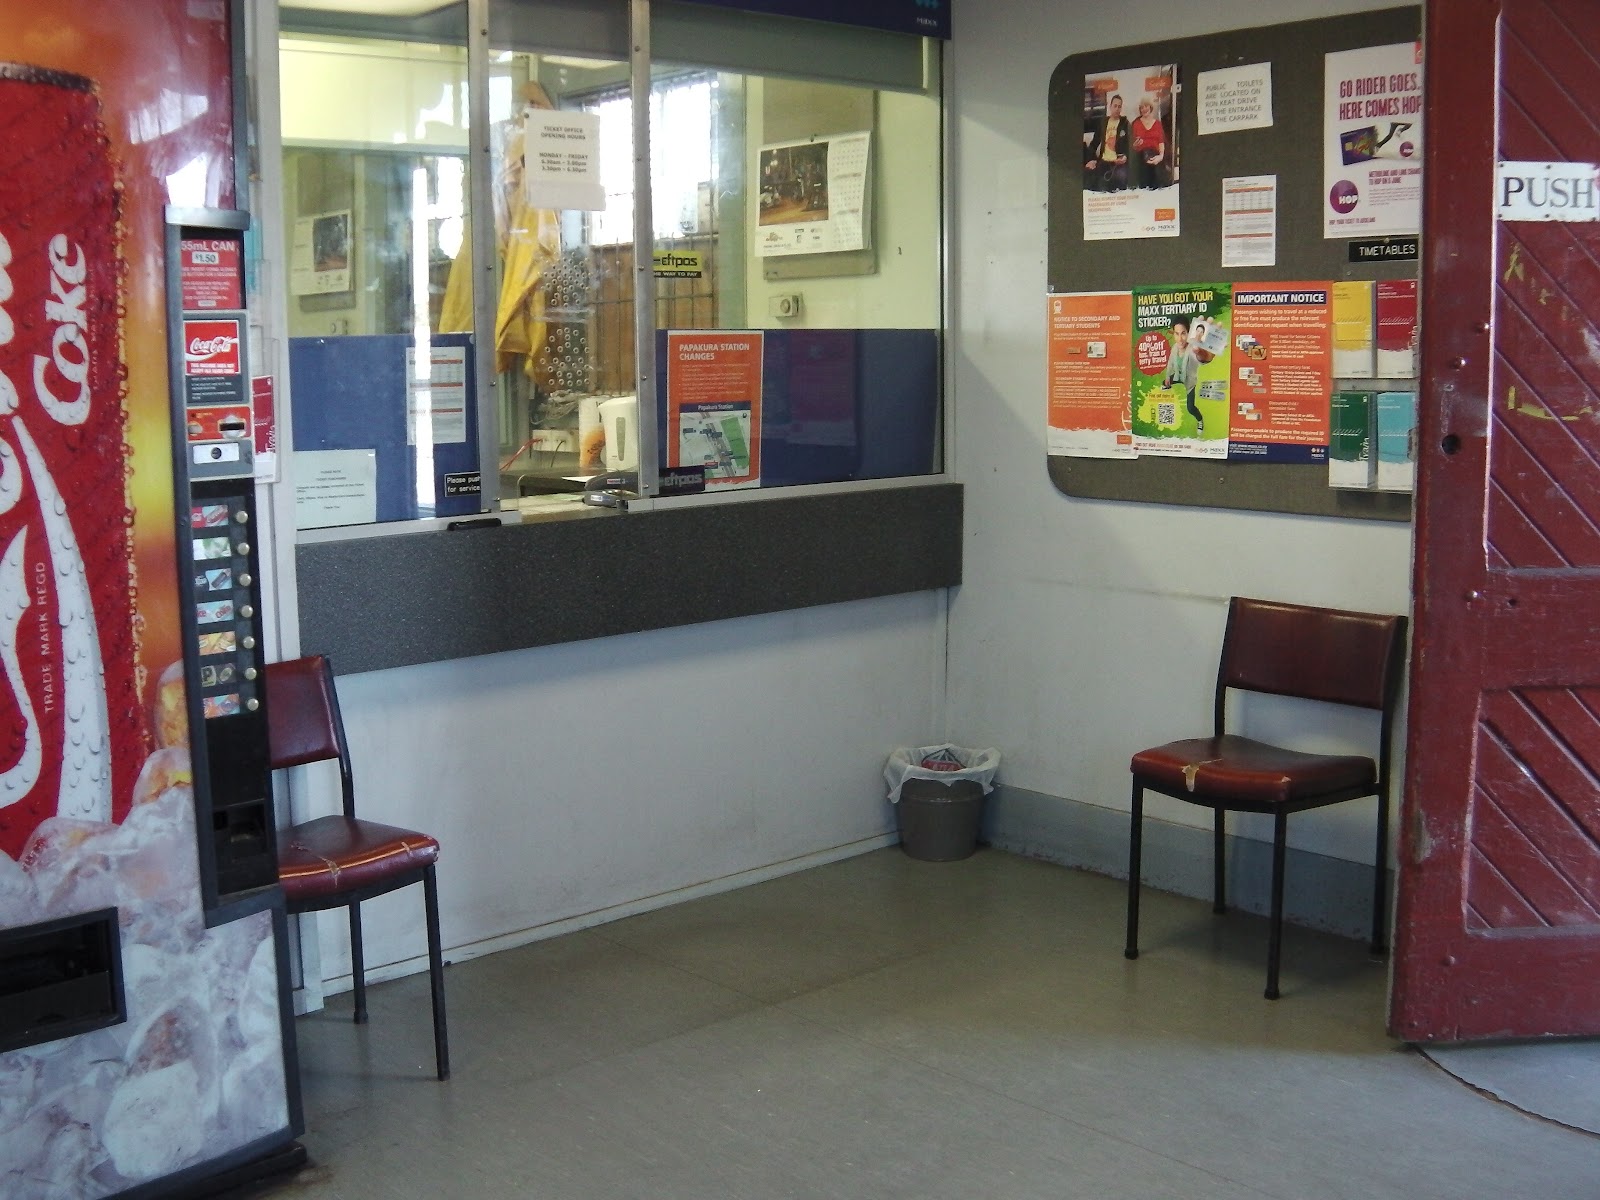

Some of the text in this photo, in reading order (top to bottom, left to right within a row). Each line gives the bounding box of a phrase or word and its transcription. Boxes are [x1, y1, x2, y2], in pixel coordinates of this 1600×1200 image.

[1206, 79, 1263, 91] PUBLIC TOILETS
[1340, 80, 1352, 98] GO
[1356, 76, 1386, 96] RIDER
[1229, 105, 1261, 113] ENTRANCE
[1340, 101, 1363, 120] HERE
[1366, 97, 1399, 117] COMES
[1501, 177, 1594, 208] PUSH
[1339, 195, 1358, 204] HOP
[181, 241, 235, 251] 55mL CAN
[1359, 244, 1415, 256] TIMETABLES
[195, 254, 216, 262] $1.50
[662, 253, 697, 268] eftpos
[1138, 291, 1213, 305] HAVE YOU GOT YOUR
[1238, 294, 1324, 303] IMPORTANT NOTICE
[1138, 303, 1207, 316] MAXX TERTIARY ID
[1138, 317, 1171, 328] STICKER?
[33, 233, 91, 426] Coke
[35, 562, 54, 713] TRADE MARK REGD
